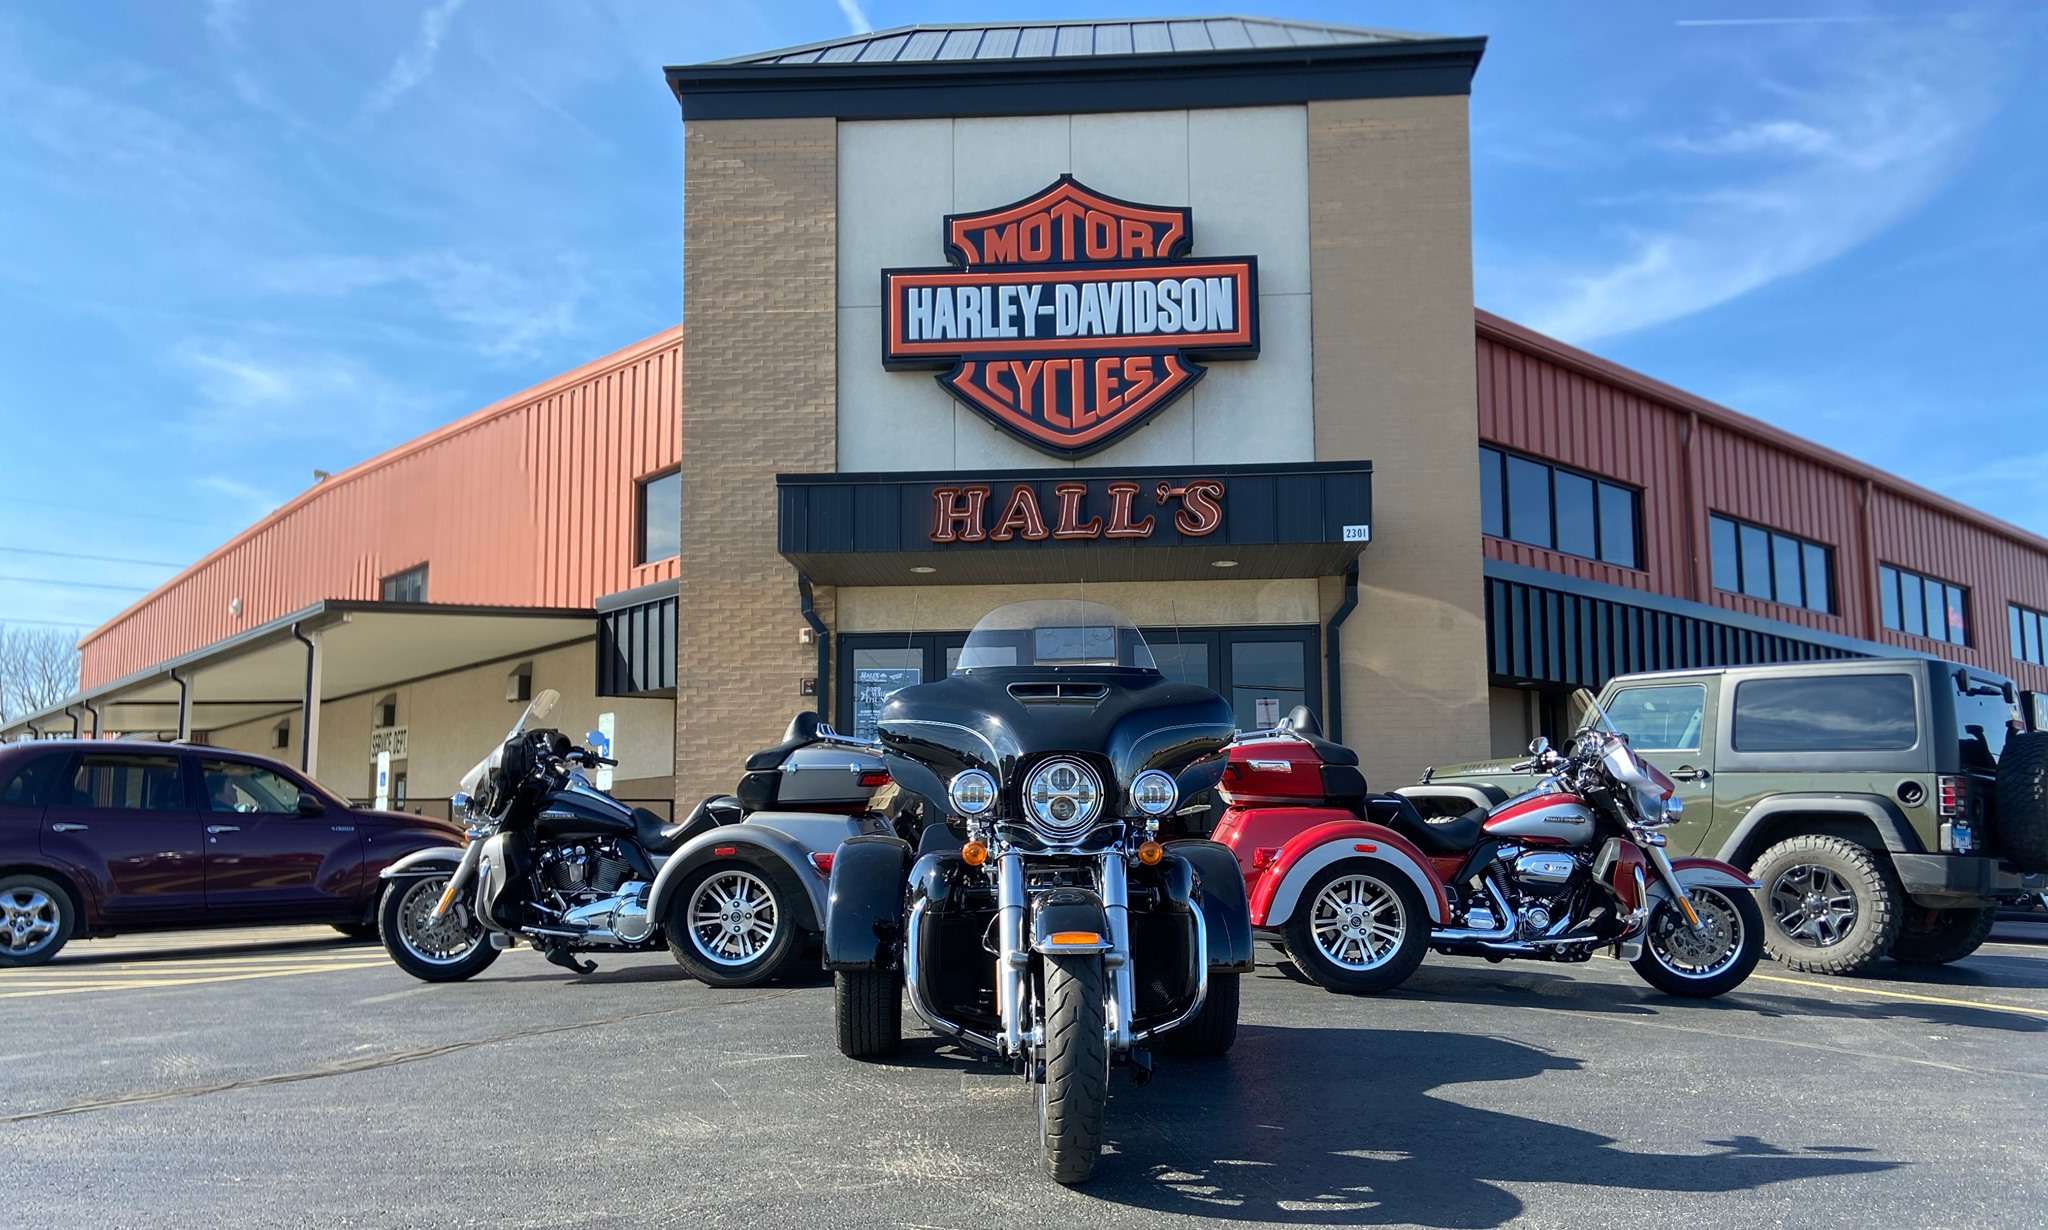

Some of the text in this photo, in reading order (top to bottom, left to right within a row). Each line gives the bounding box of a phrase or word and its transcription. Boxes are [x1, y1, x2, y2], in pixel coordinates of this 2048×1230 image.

[983, 199, 1154, 264] MOTOR
[907, 277, 1235, 341] HARLEY-DAVIDSON
[985, 355, 1154, 430] CYCLES
[928, 480, 1225, 543] HALL'S
[1346, 528, 1366, 538] 2301
[371, 732, 392, 757] SERVICE
